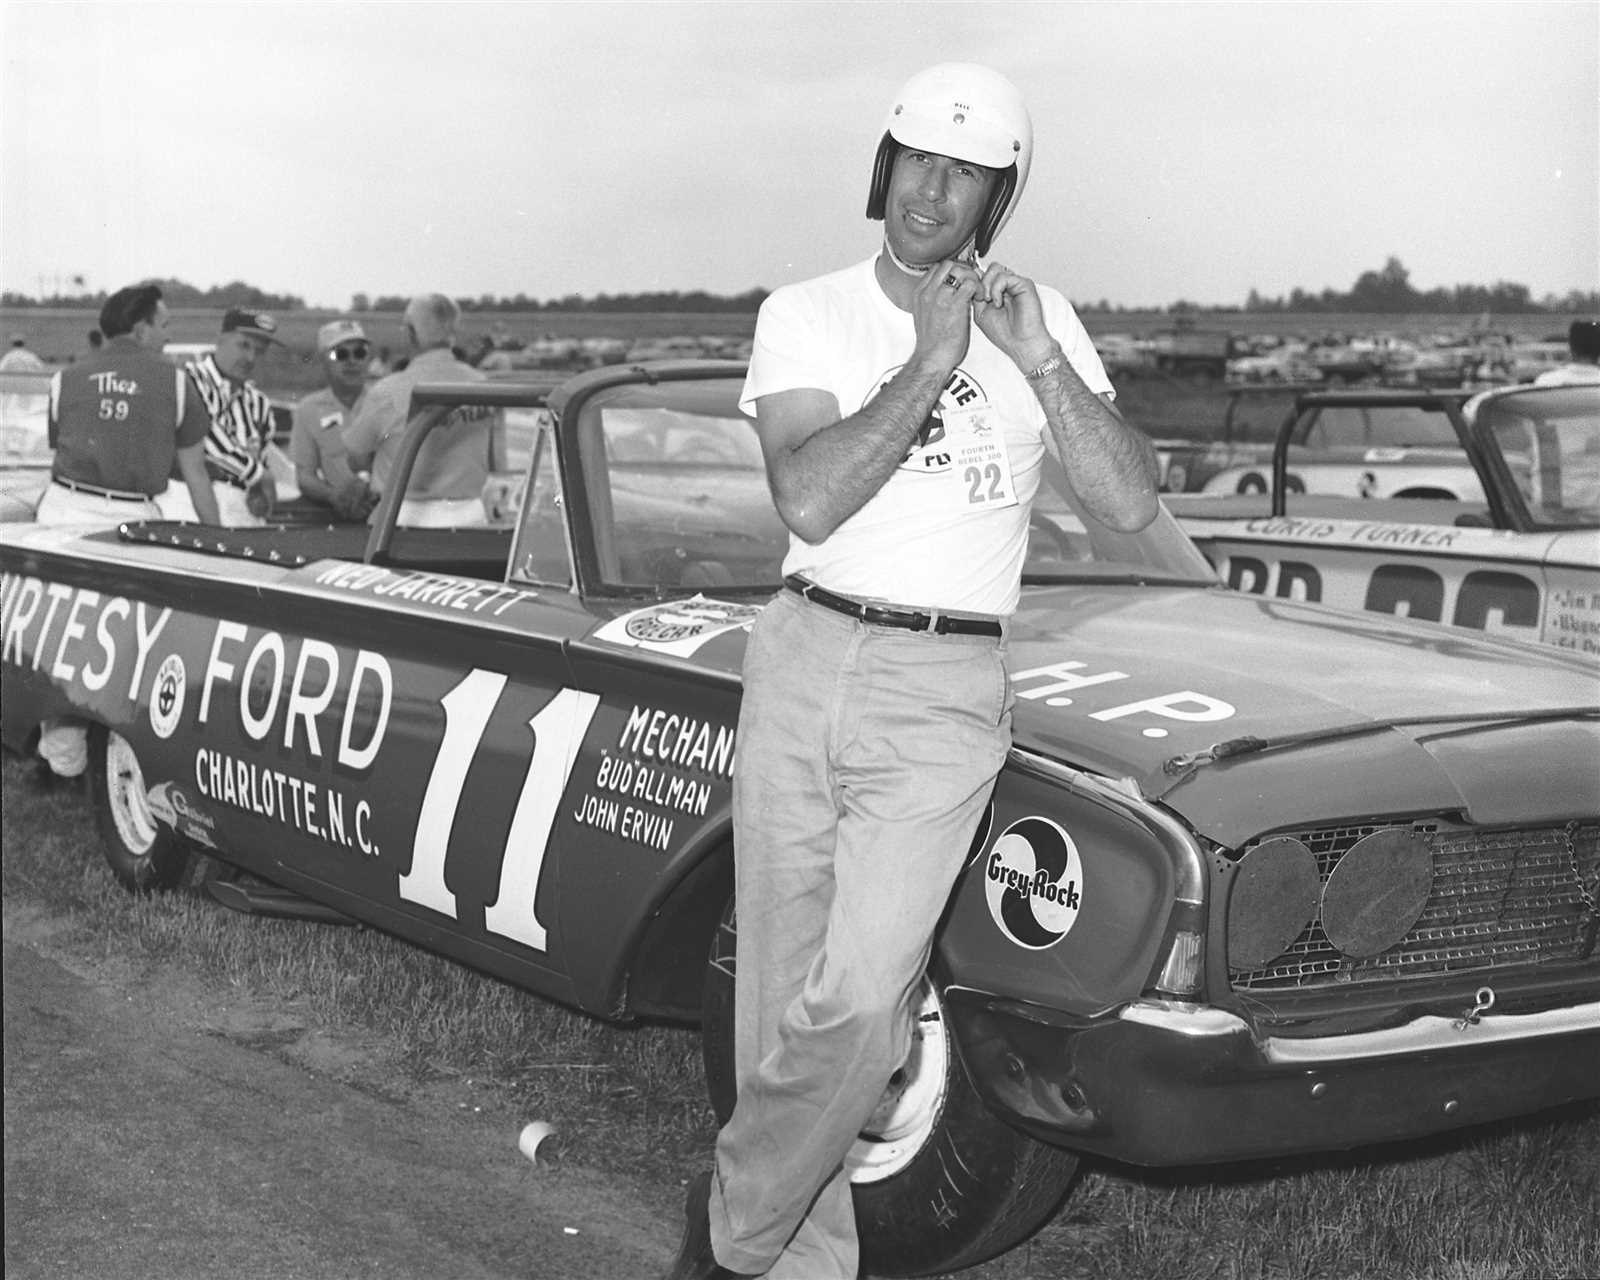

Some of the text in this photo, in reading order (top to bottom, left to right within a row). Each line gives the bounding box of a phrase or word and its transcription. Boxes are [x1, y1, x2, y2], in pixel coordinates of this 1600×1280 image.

[98, 398, 129, 421] 59
[944, 373, 978, 407] ITE
[964, 463, 1005, 504] 22
[1351, 522, 1461, 547] TURNER
[316, 562, 538, 616] NED JARRETT
[199, 619, 393, 769] FORD
[399, 668, 601, 952] 11
[633, 766, 711, 816] ALLMAN
[574, 793, 673, 850] JOHN ERVIN
